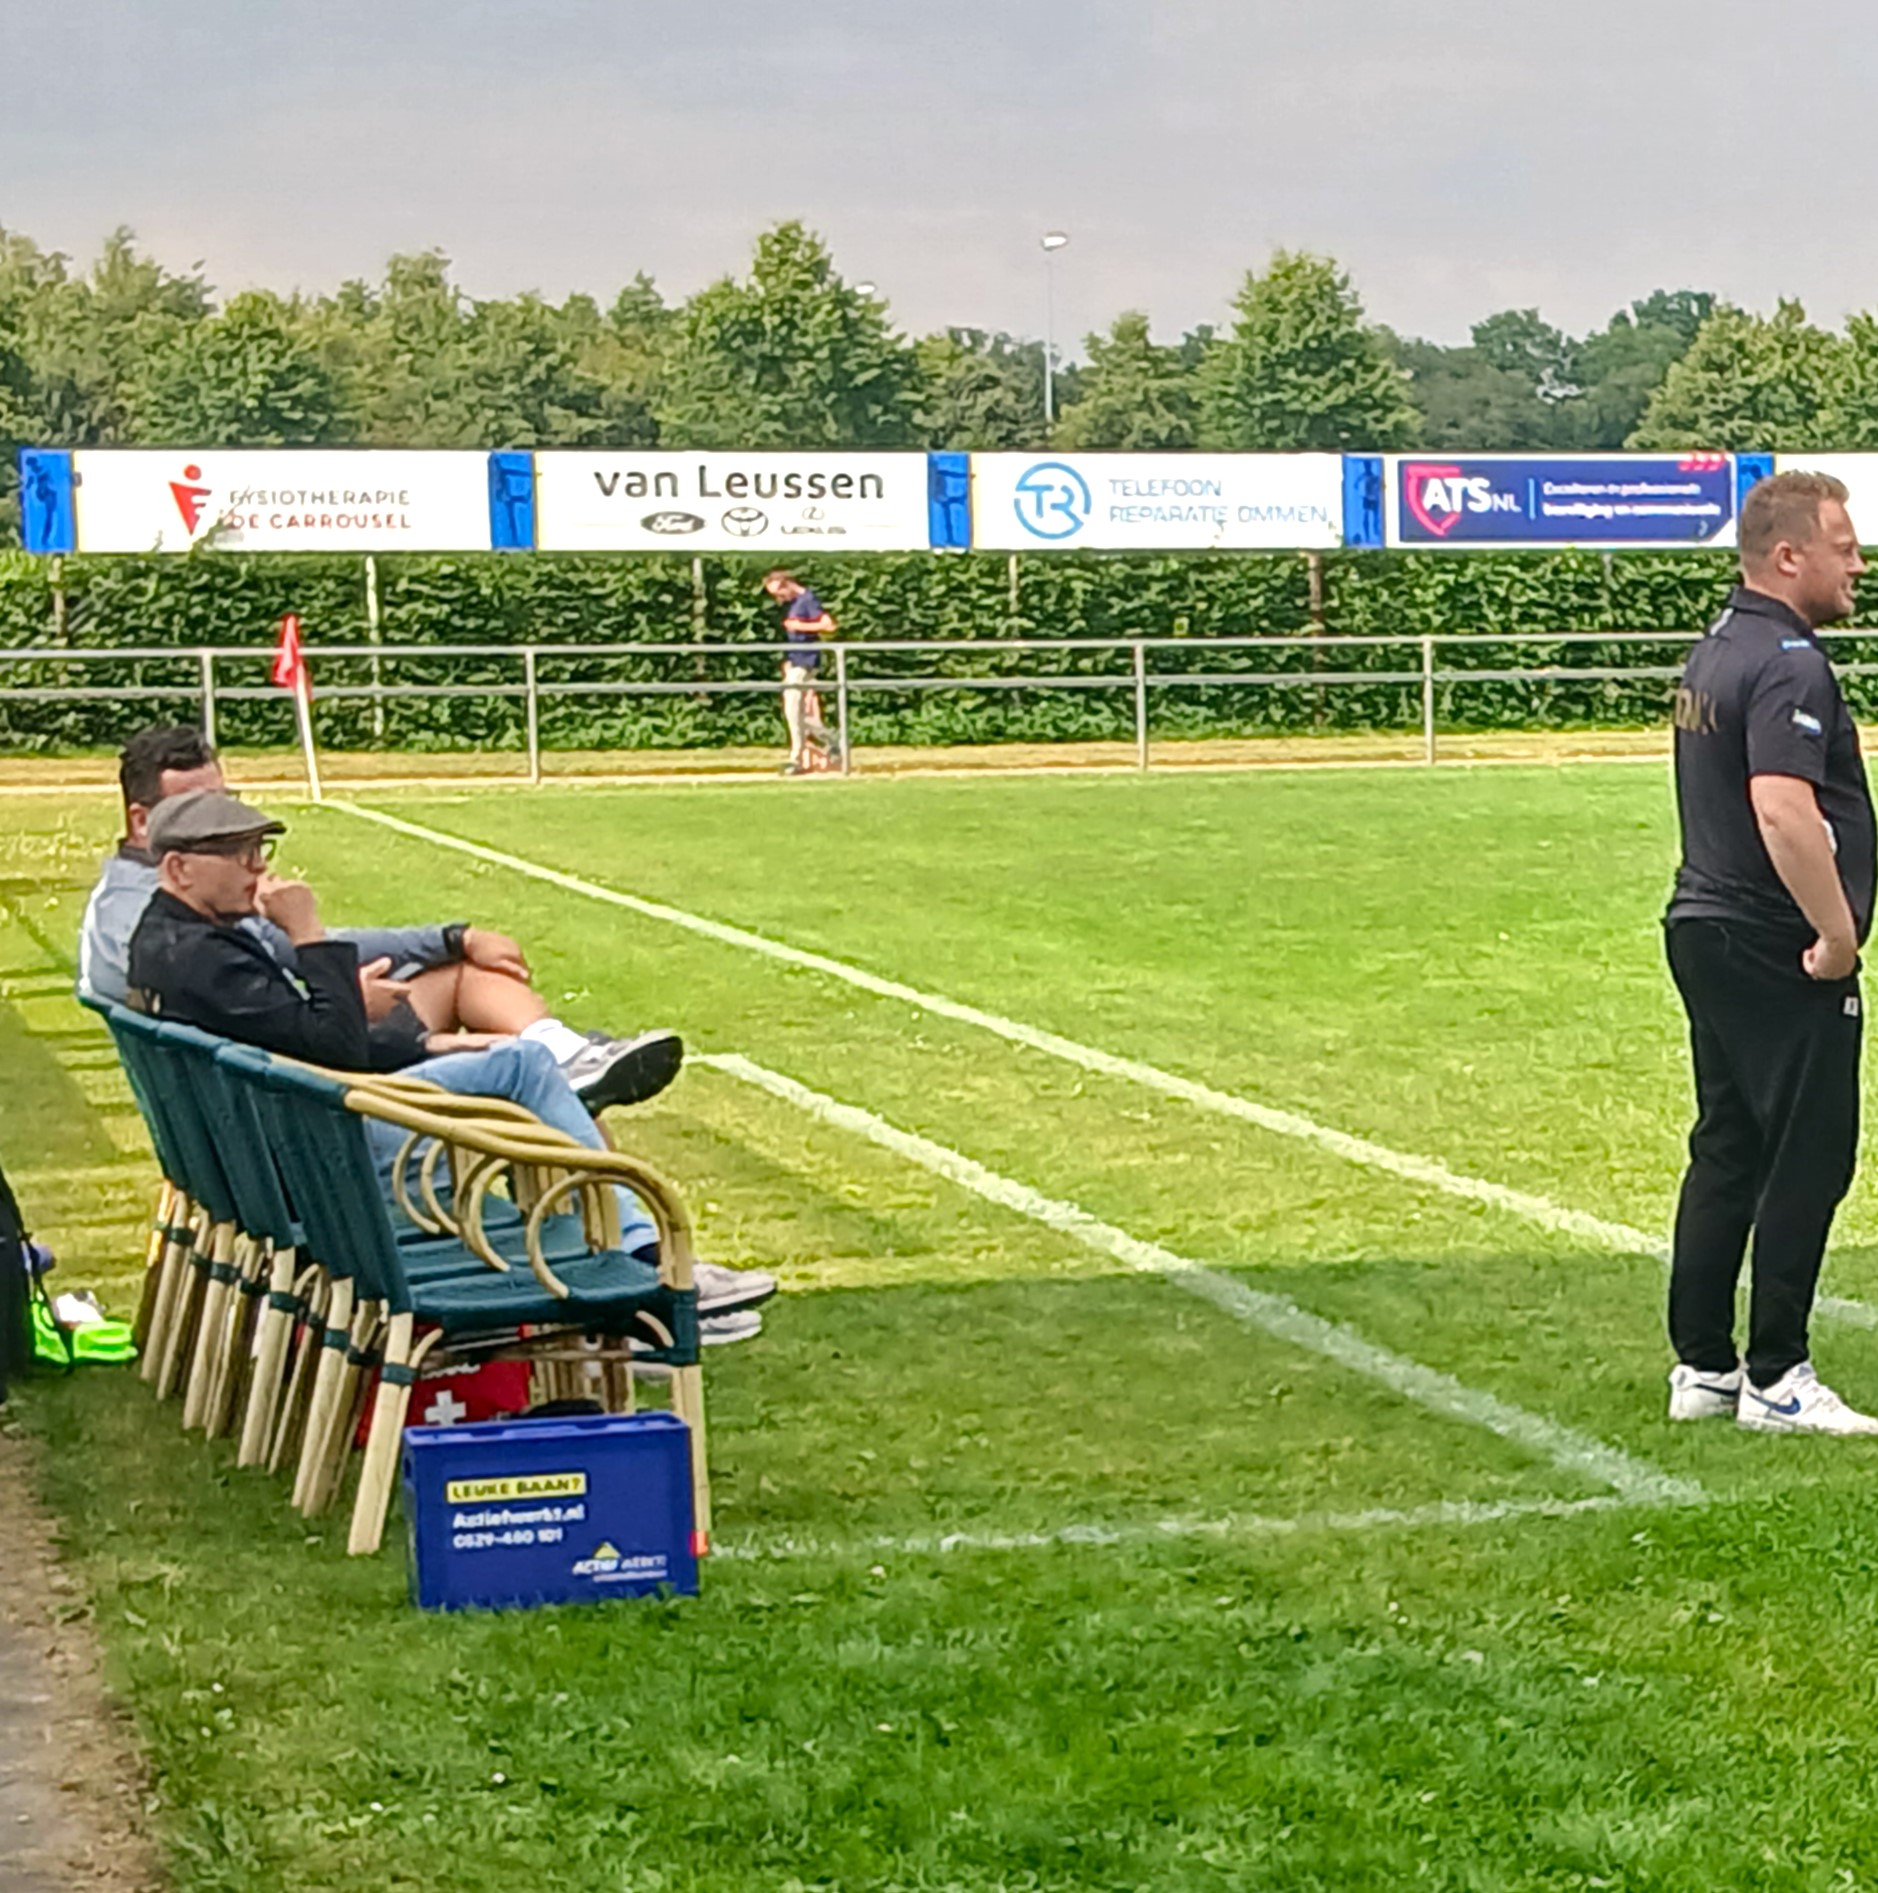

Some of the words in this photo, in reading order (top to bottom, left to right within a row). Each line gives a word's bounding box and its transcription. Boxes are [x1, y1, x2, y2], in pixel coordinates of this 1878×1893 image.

[593, 471, 679, 498] van
[698, 464, 885, 499] Leussen
[1107, 478, 1222, 497] TELEFOON
[229, 490, 412, 506] FYSIOTHERAPIE
[269, 513, 412, 529] CARROUSEL
[1237, 505, 1328, 523] OMMEN
[453, 1482, 511, 1498] LEUKE
[516, 1478, 581, 1494] BAAN?
